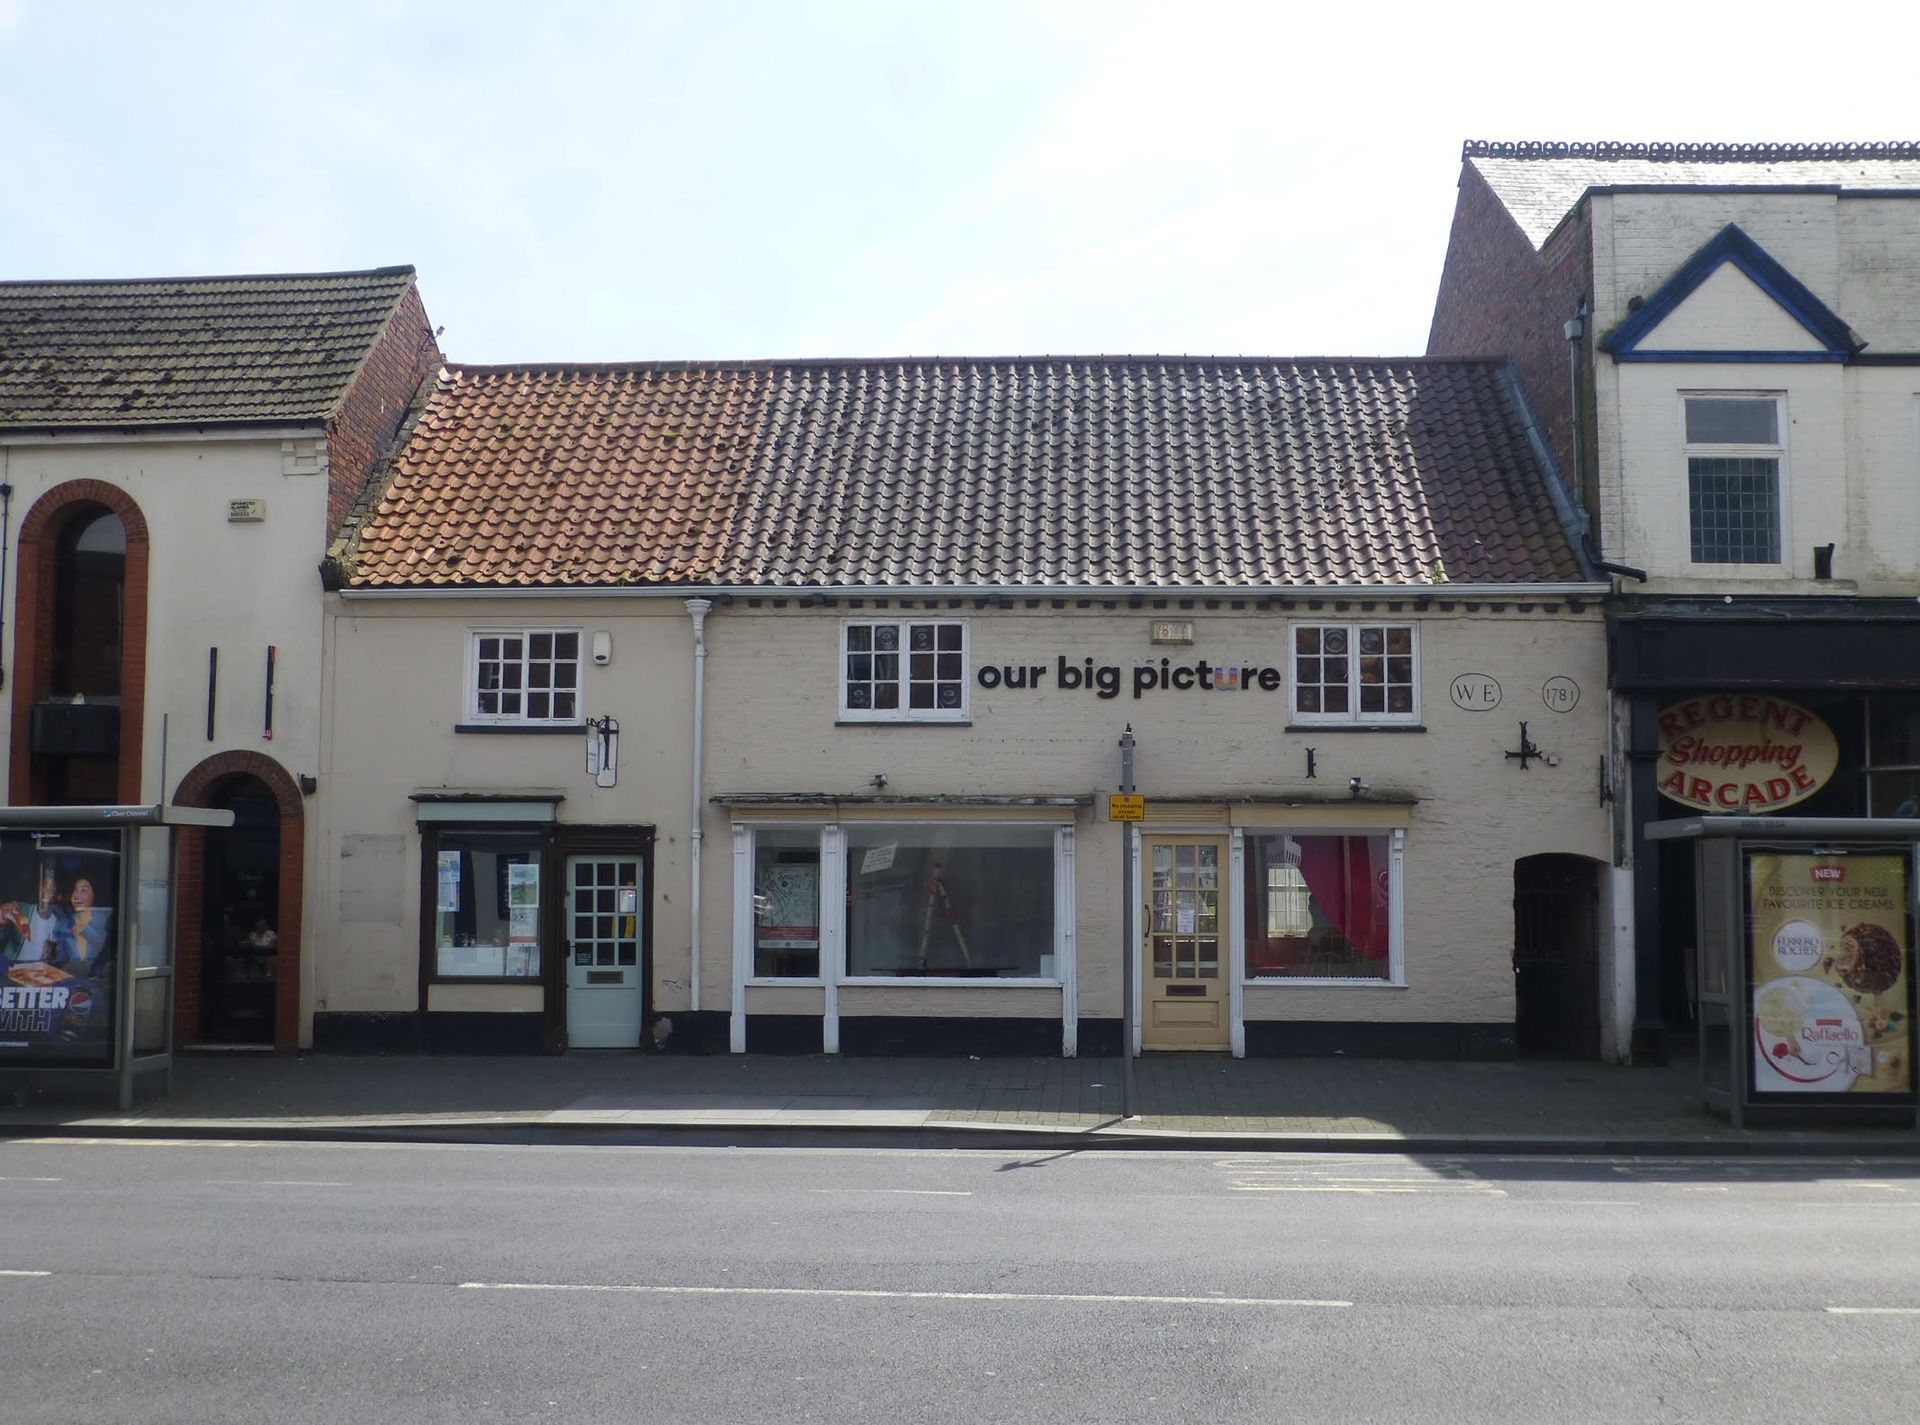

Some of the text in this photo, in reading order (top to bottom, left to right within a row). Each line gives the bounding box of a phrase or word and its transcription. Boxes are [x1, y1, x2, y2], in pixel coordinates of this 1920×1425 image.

[977, 656, 1282, 699] our big picture
[1456, 684, 1496, 702] W E
[1546, 688, 1574, 707] 1781
[1659, 696, 1814, 737] REGENT
[1666, 736, 1803, 770] Shopping
[1659, 765, 1818, 808] ARCADE
[1814, 869, 1841, 878] NEW
[1768, 886, 1888, 897] DISCOVER YOUR NEW
[1763, 899, 1895, 910] FAVOURITE ICE CREAMS
[1778, 946, 1818, 955] ROCHER
[0, 986, 69, 1009] ETTER
[1802, 1027, 1858, 1042] Raffaello
